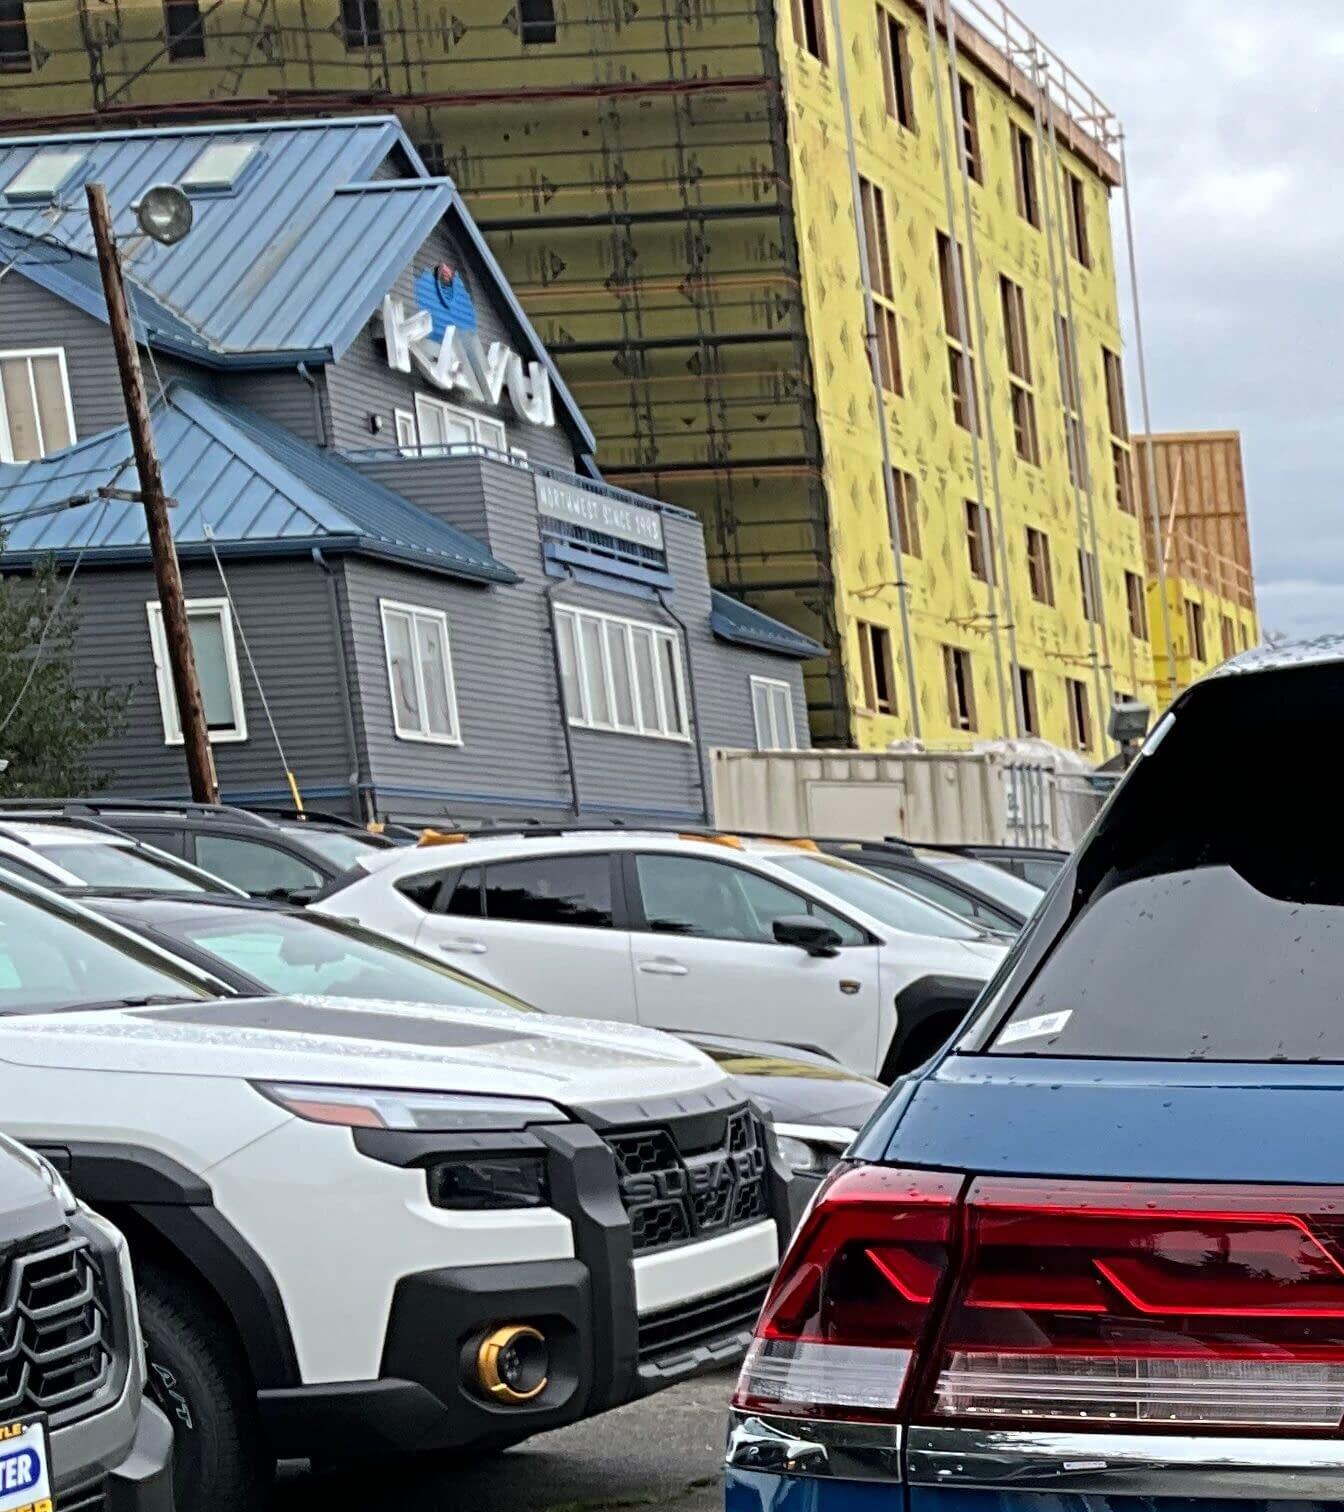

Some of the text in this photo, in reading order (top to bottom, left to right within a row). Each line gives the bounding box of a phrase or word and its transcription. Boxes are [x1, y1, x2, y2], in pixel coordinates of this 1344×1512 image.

[383, 294, 555, 427] KAVU
[602, 503, 632, 531] SINCE
[619, 1146, 765, 1201] SUBARU
